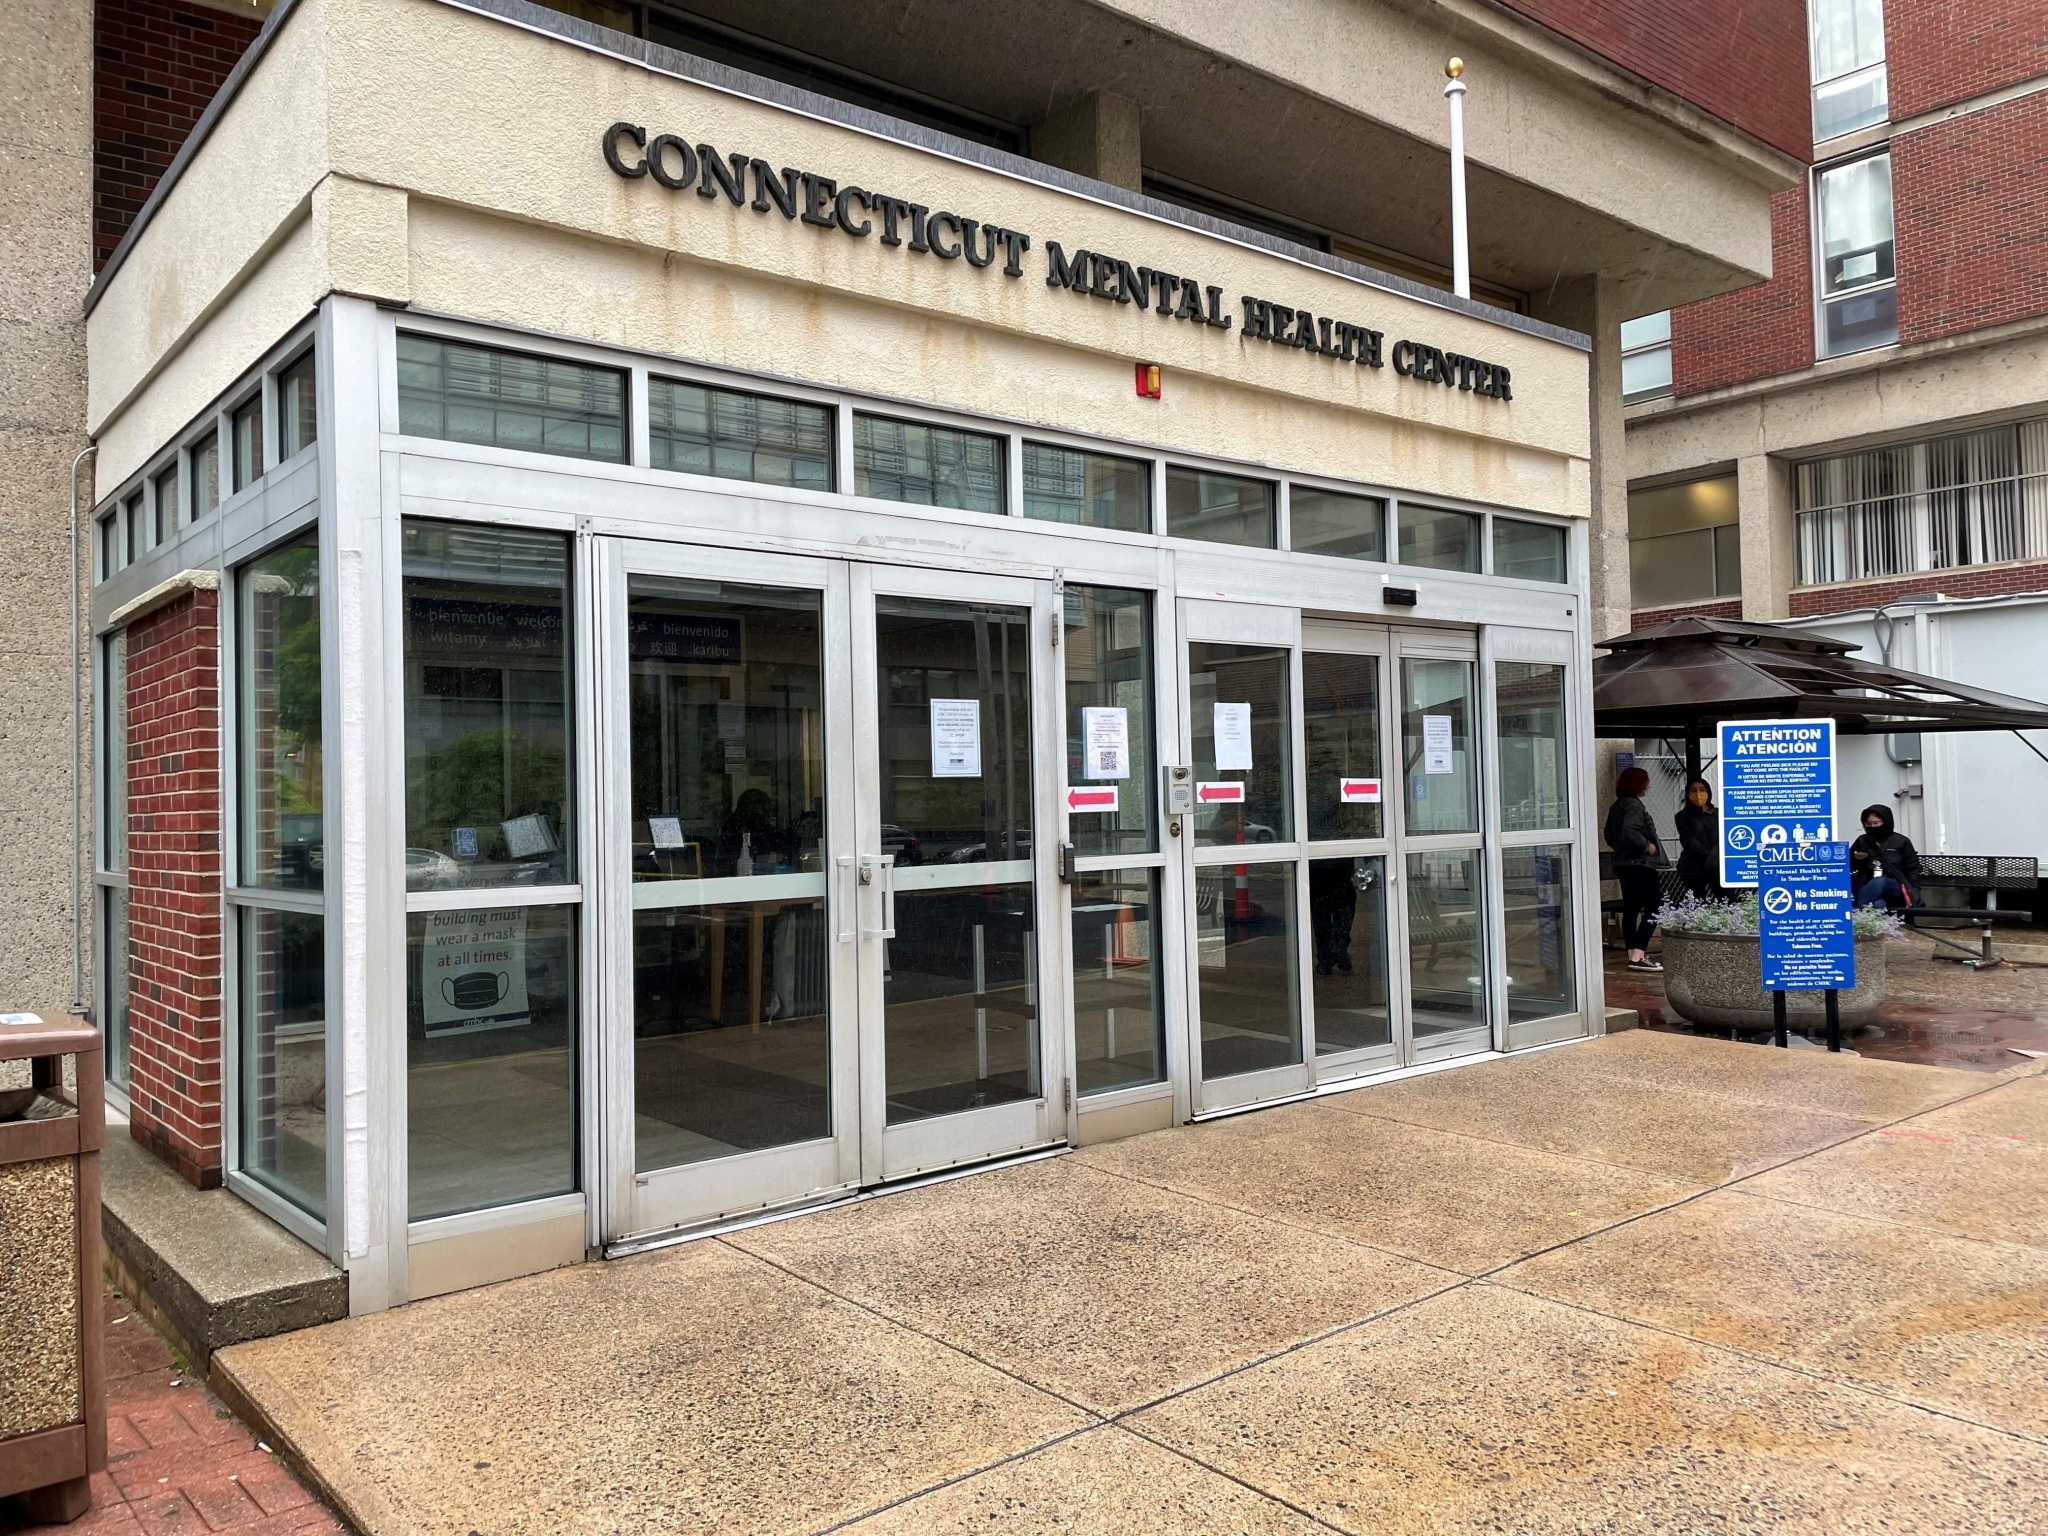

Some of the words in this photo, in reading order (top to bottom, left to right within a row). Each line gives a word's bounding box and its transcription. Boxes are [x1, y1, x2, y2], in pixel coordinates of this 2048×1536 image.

[602, 121, 1030, 277] CONNECTICUT
[1045, 240, 1231, 329] MENTAL
[1241, 296, 1384, 368] HEALTH
[1392, 339, 1513, 401] CENTER
[664, 622, 728, 638] bienvenido
[1732, 729, 1821, 742] ATTENTION
[1736, 740, 1817, 755] ATENCIÓN
[1759, 846, 1814, 862] CMHC
[1795, 889, 1807, 898] No
[1810, 888, 1848, 898] Smoking
[1796, 902, 1808, 910] No
[1811, 901, 1838, 910] Fumar
[434, 912, 487, 926] building
[490, 909, 521, 921] must
[436, 934, 468, 945] wear
[472, 933, 479, 942] a
[483, 927, 515, 941] mask
[438, 954, 450, 967] at
[454, 951, 470, 965] all
[474, 950, 512, 963] times.
